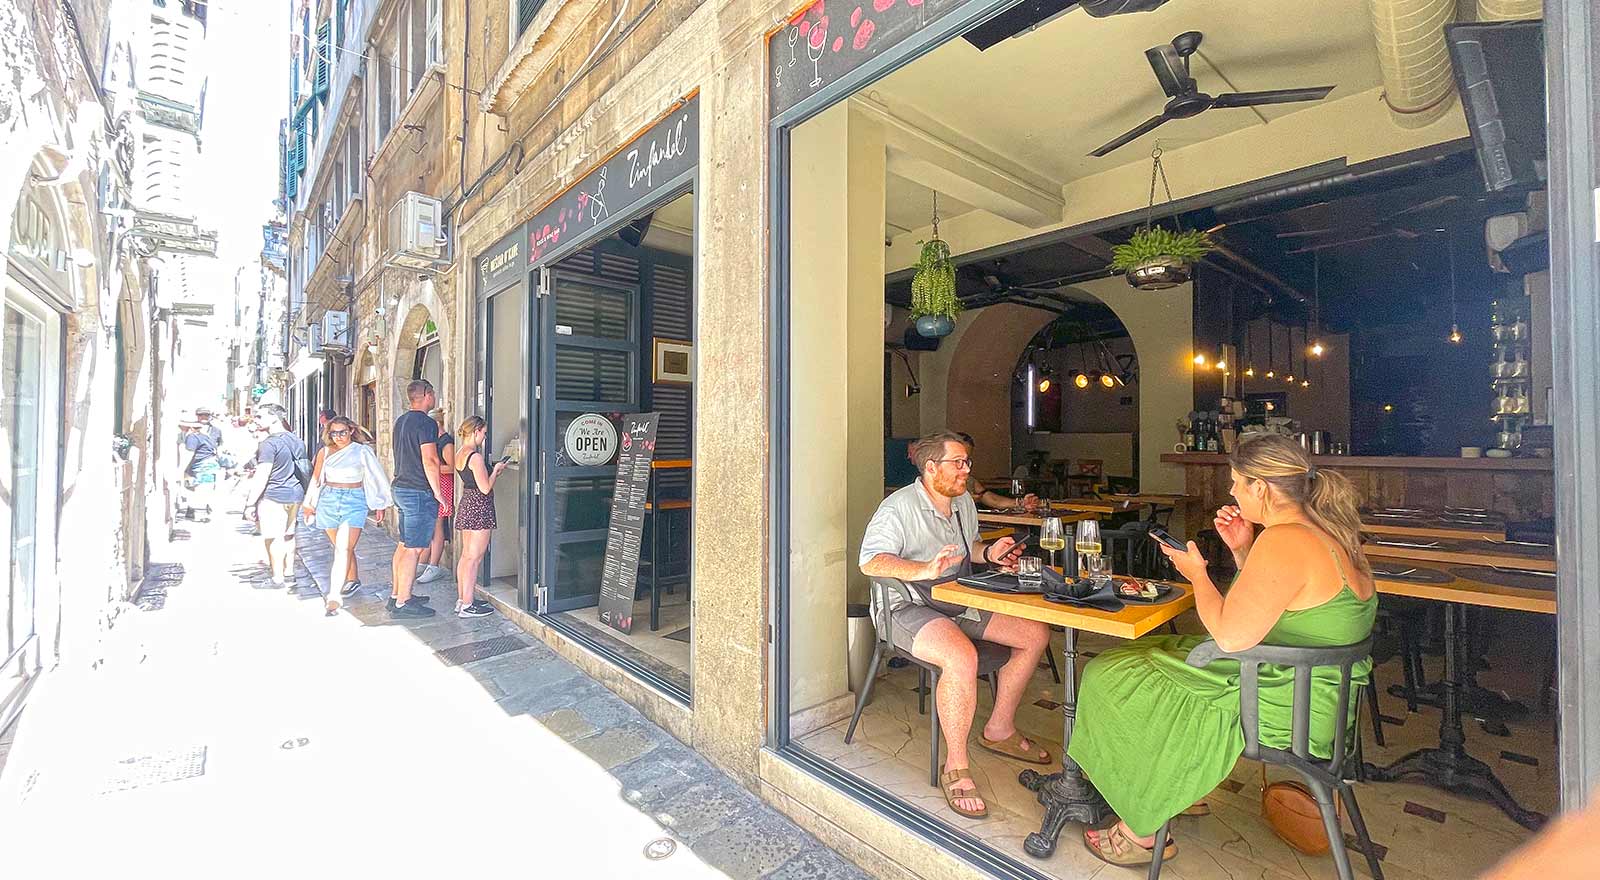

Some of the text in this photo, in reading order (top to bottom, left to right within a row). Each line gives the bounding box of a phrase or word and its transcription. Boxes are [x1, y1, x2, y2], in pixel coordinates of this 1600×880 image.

[579, 428, 604, 436] We Are
[576, 437, 607, 451] OPEN
